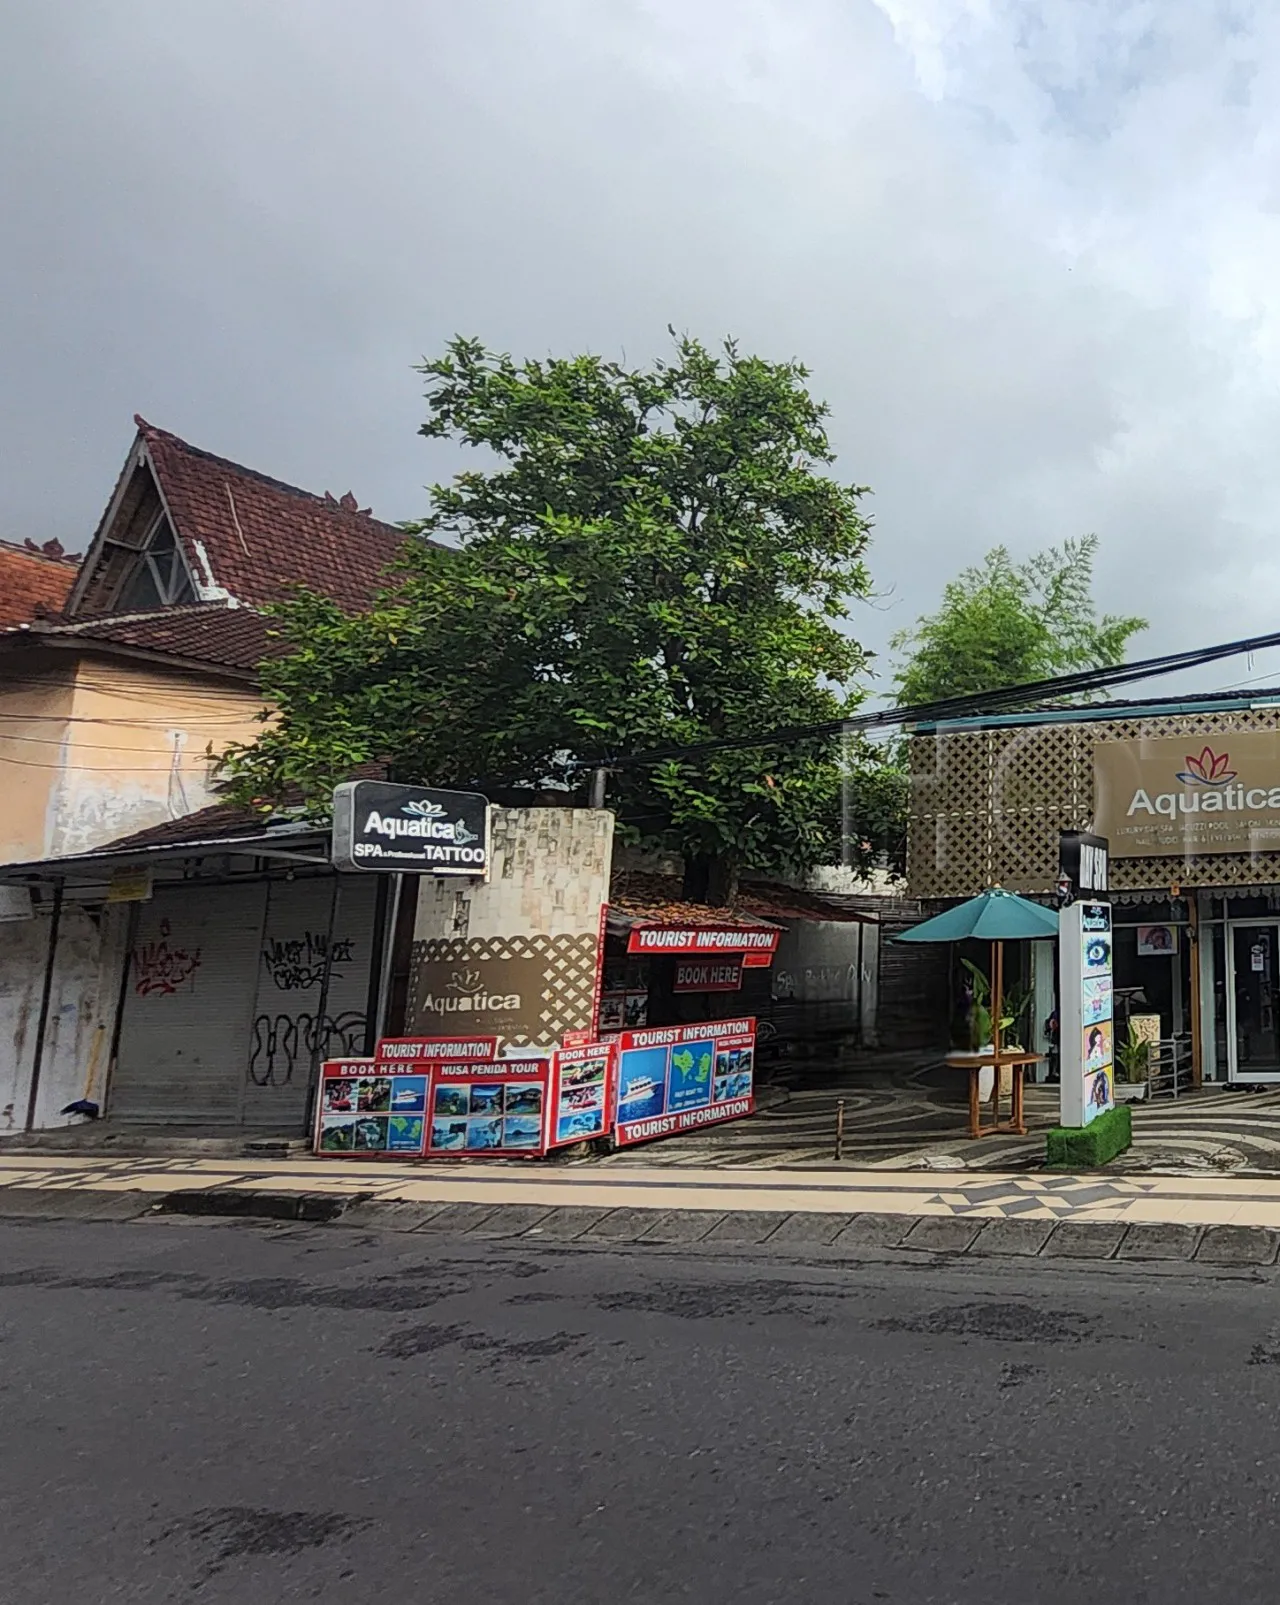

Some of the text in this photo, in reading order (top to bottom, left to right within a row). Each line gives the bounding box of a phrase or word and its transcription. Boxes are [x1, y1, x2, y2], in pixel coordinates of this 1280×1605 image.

[363, 810, 455, 840] Aquatica
[354, 843, 383, 857] SPA
[423, 844, 485, 863] TATTOO
[639, 930, 774, 948] TOURIST INFORMATION
[677, 966, 739, 985] BOOK HERE
[422, 991, 521, 1016] Aquatica
[632, 1028, 681, 1046] TOURIST
[682, 1021, 749, 1040] INFORMATION
[381, 1042, 491, 1058] TOURIST INFORMATION
[558, 1046, 611, 1061] BOOK HERE
[340, 1064, 414, 1075] BOOK HERE
[441, 1063, 539, 1075] NUSA PENIDA TOUR
[625, 1117, 677, 1139] TOURIST
[679, 1101, 749, 1126] INFORMATION
